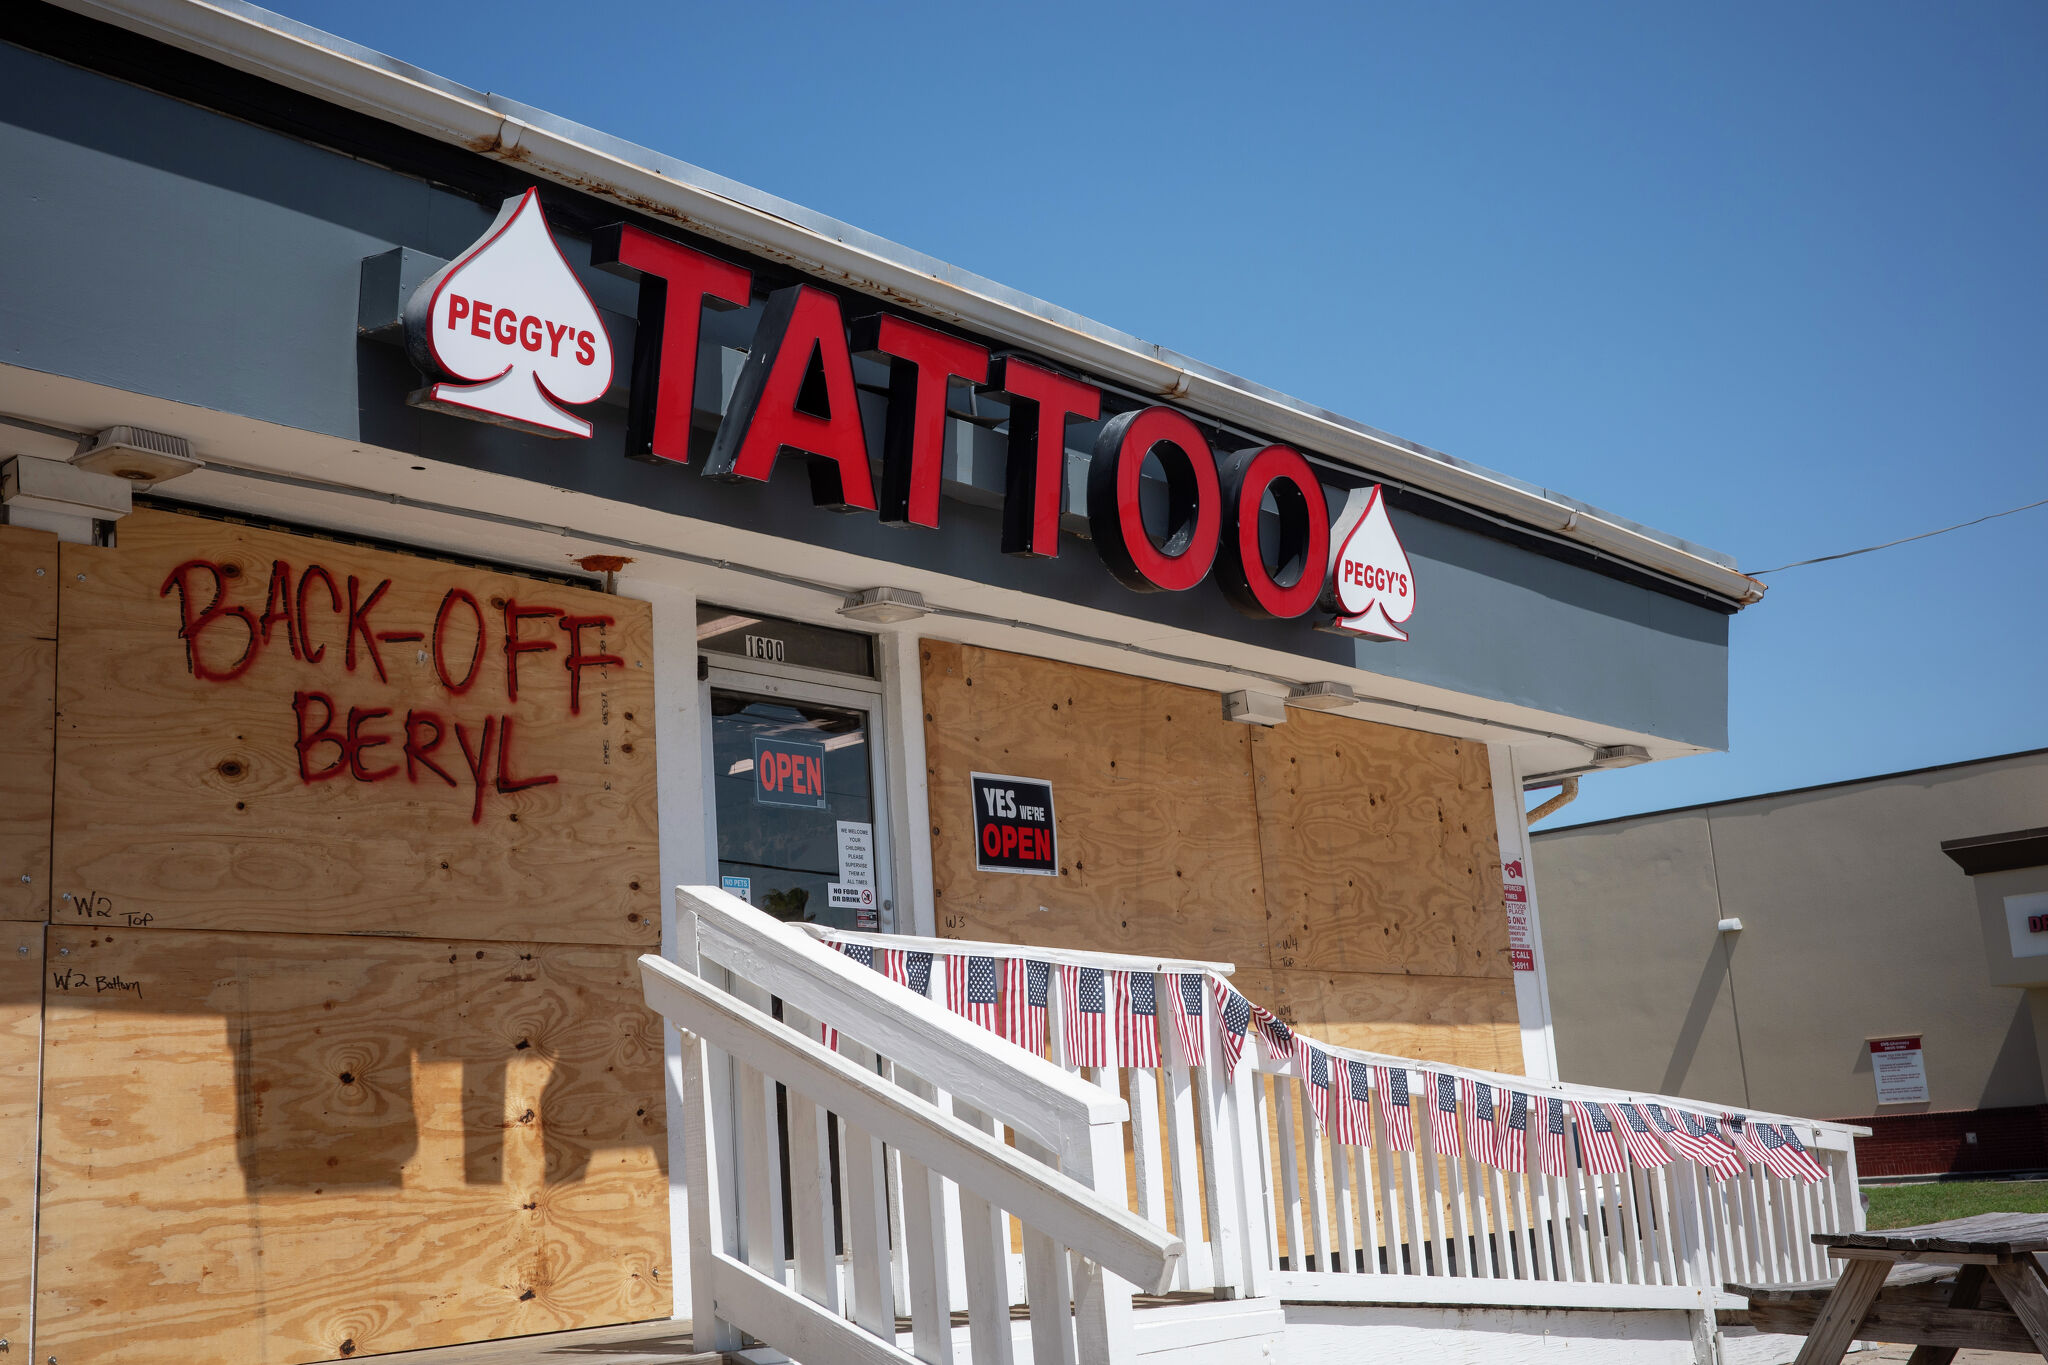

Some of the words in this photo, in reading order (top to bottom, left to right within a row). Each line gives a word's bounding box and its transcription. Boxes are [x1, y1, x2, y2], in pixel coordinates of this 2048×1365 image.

[448, 293, 596, 366] PEGGY'S
[617, 222, 1331, 619] TATTOO
[1344, 559, 1407, 598] PEGGY'S
[160, 558, 626, 718] BACK-OFF
[748, 636, 784, 663] 1600
[291, 690, 560, 826] BERYL
[759, 749, 823, 797] OPEN
[983, 787, 1017, 819] YES
[1019, 805, 1045, 822] WE'RE
[848, 828, 869, 836] WELCOME
[982, 823, 1052, 861] OPEN
[73, 888, 113, 918] W2
[833, 887, 842, 895] NO
[843, 888, 859, 896] FOOD
[1512, 917, 1527, 925] ONLY
[1516, 951, 1530, 959] CALL
